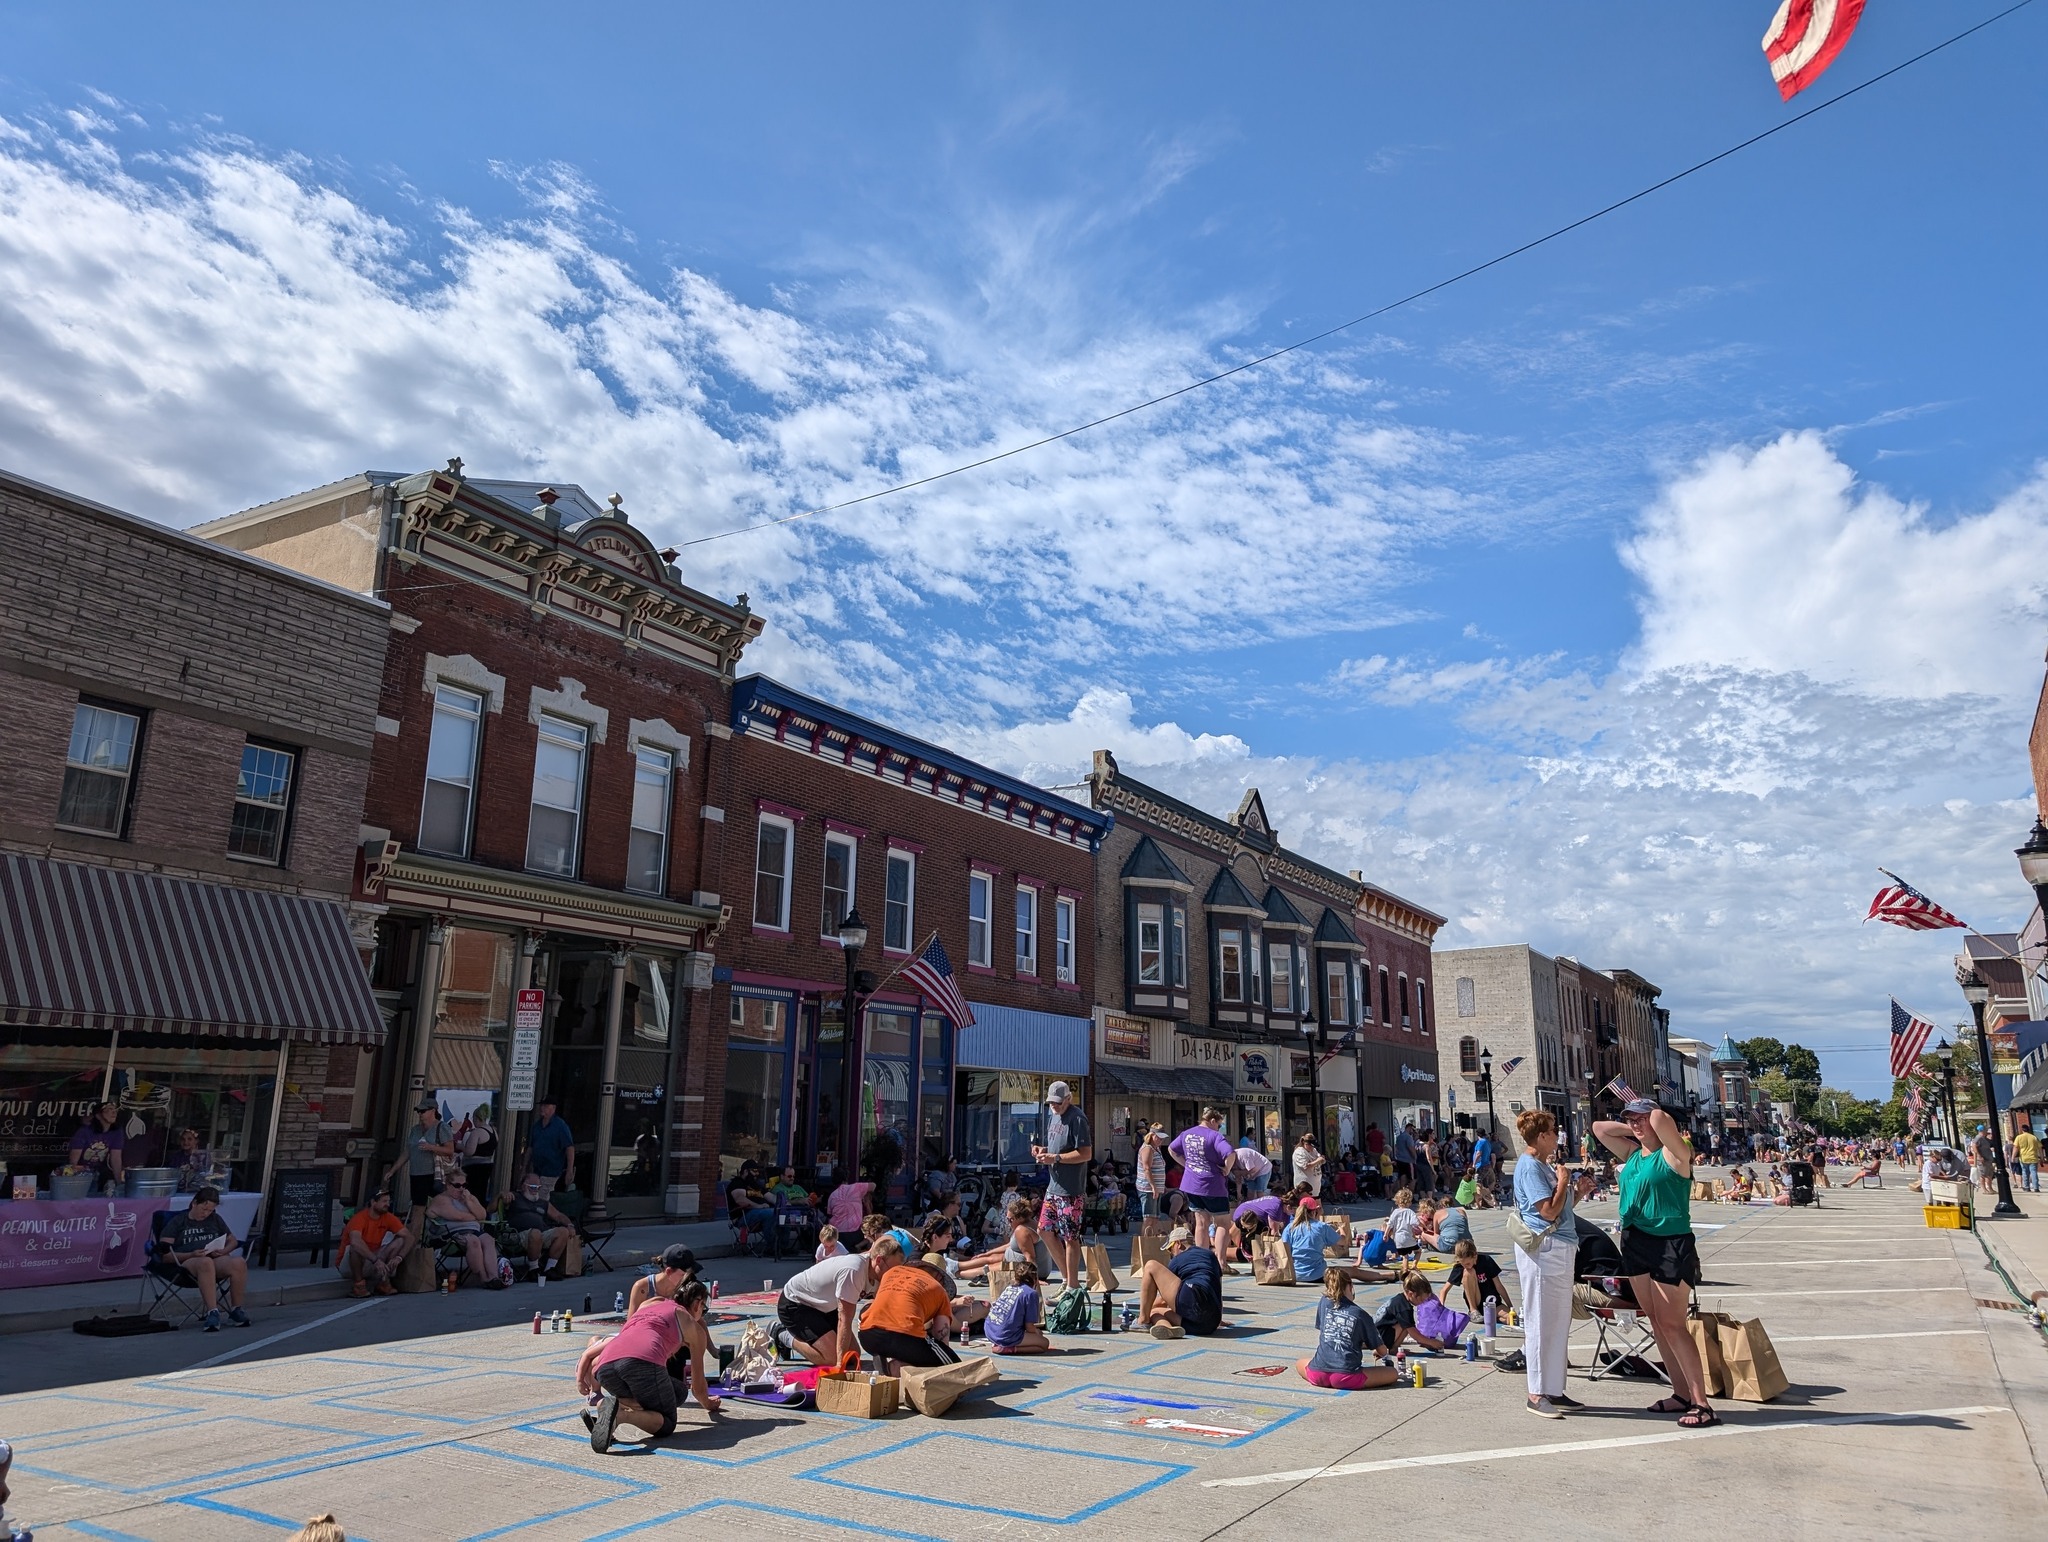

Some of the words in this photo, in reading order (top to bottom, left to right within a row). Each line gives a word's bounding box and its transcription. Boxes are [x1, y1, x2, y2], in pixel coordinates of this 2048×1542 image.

[572, 598, 603, 618] 1879
[526, 993, 536, 1001] NO
[519, 1002, 541, 1010] PARKING
[1107, 1029, 1124, 1042] HERE
[1124, 1032, 1142, 1044] NOW!
[1408, 1068, 1420, 1082] April
[1420, 1070, 1435, 1083] House
[619, 1090, 653, 1100] Ameriprise
[1235, 1094, 1254, 1102] COLD
[1257, 1095, 1277, 1103] BEER
[1, 1119, 16, 1135] &
[23, 1119, 58, 1135] deli
[2, 1220, 50, 1235] PEANUT
[53, 1217, 97, 1233] BUTTER
[25, 1239, 39, 1251] &
[43, 1237, 72, 1250] deli
[20, 1258, 59, 1268] desserts
[65, 1255, 93, 1265] coffee
